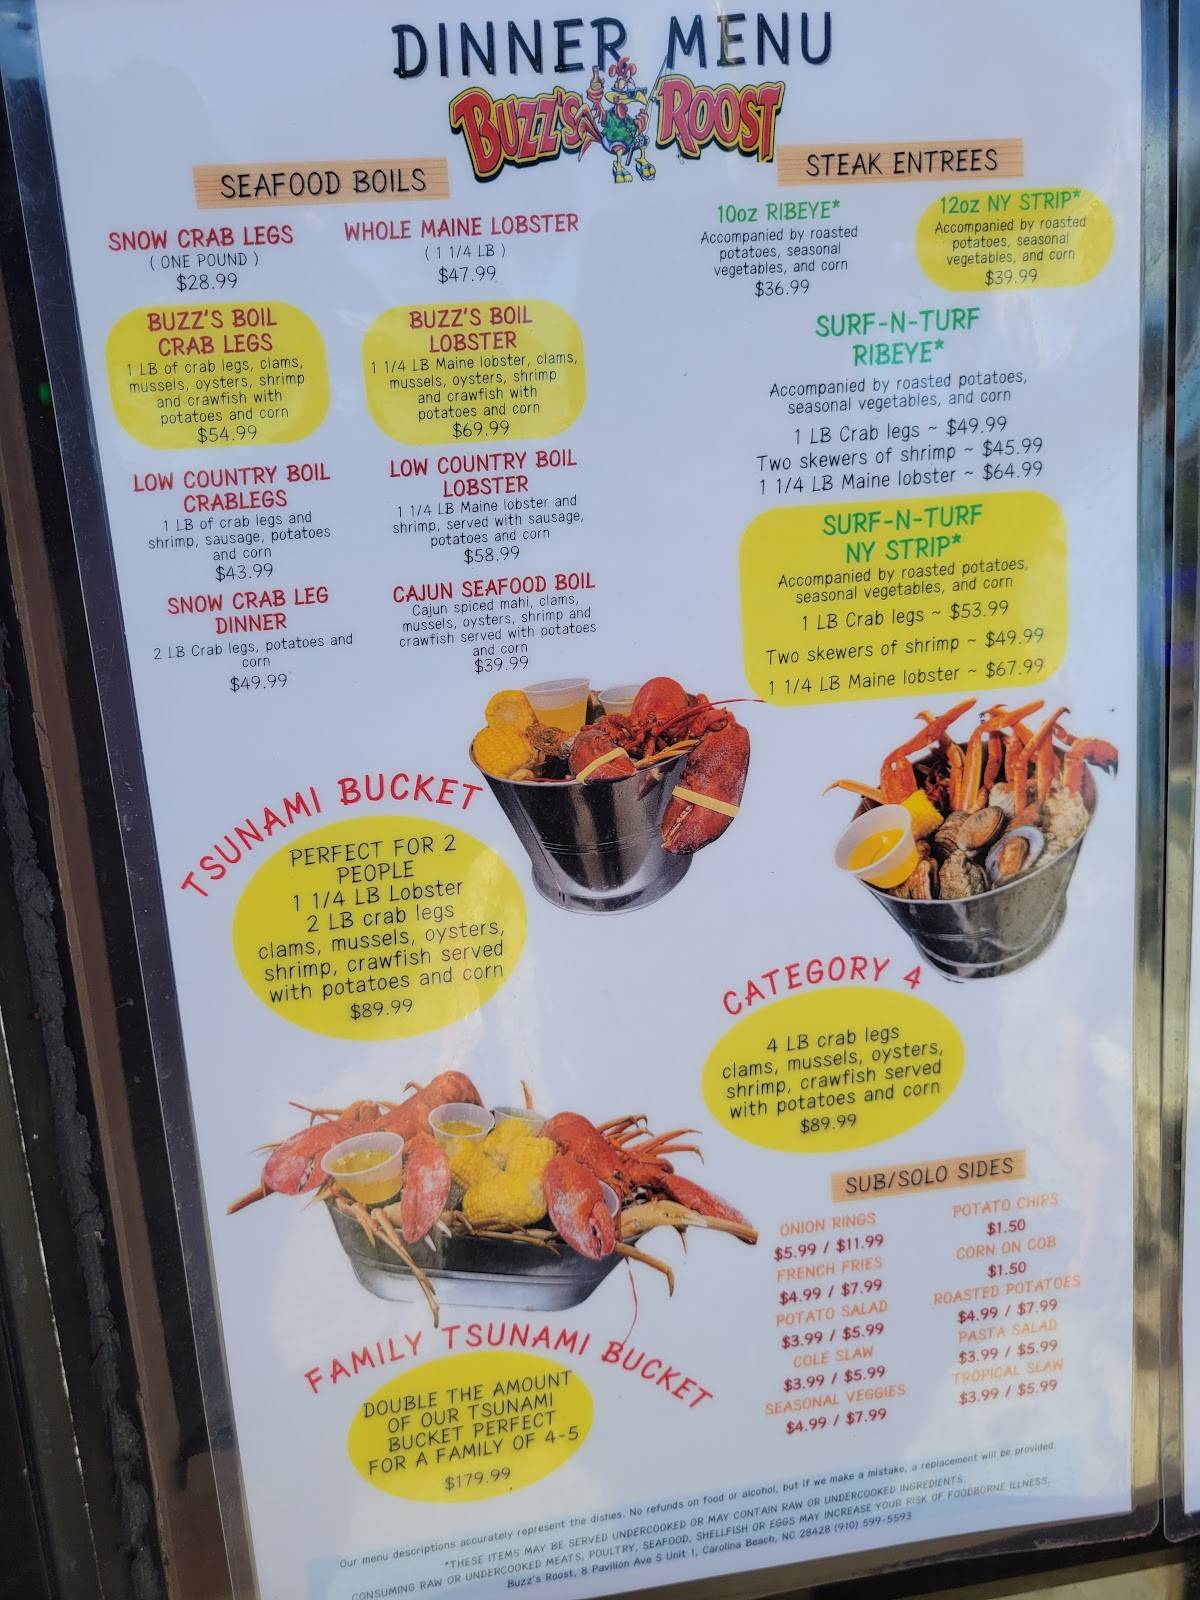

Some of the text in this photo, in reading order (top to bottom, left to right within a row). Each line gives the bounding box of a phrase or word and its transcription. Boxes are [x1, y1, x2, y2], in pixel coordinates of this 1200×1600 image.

[392, 12, 832, 79] DINNER MENU
[450, 76, 785, 178] BUZZ'S ROOST
[806, 148, 997, 177] STEAK ENTREES
[220, 167, 426, 199] SEAFOOD BOILS
[717, 204, 759, 224] 10oz
[940, 195, 980, 215] 12oz
[987, 193, 1011, 212] NY
[108, 224, 293, 251] SNOW CRAB LEGS
[343, 212, 578, 241] WHOLE MAINE LOBSTER
[700, 224, 857, 245] Accompanied by roasted
[719, 241, 840, 262] potatoes, seasonal
[437, 265, 495, 284] $47.99
[713, 258, 847, 278] vegetables, and corn
[984, 268, 1037, 287] $39.99
[176, 272, 237, 292] $28.99
[754, 279, 809, 298] $36.99
[146, 307, 277, 332] BUZZ'S BOIL
[408, 304, 533, 330] BUZZ'S BOIL
[815, 306, 980, 337] SURF-N-TURF
[158, 332, 273, 356] CRAB LEGS
[429, 330, 517, 353] LOBSTER
[197, 424, 257, 444] $54.99
[451, 419, 509, 439] $69.99
[389, 448, 577, 478] LOW COUNTRY BOIL
[133, 462, 331, 492] LOW COUNTRY BOIL
[442, 474, 528, 498] LOBSTER
[183, 489, 287, 513] CRABLEGS
[822, 503, 983, 536] SURF-N-TURF
[463, 545, 519, 565] $58.99
[845, 540, 876, 564] NY
[215, 562, 273, 582] $43.99
[393, 571, 595, 603] CAJUN SEAFOOD BOIL
[167, 585, 328, 614] SNOW CRAB LEG
[215, 612, 287, 634] DINNER
[474, 655, 528, 674] $39.99
[229, 672, 287, 693] $49.99
[181, 773, 483, 896] TSUNAMI BUCKET
[288, 834, 456, 867] PERFECT FOR 2
[336, 859, 414, 884] PEOPLE
[722, 956, 922, 1016] CATEGORY 4
[350, 998, 412, 1020] $89.99
[722, 1042, 942, 1079] clams, mussels, oysters,
[799, 1113, 856, 1135] $89.99
[845, 1157, 1014, 1194] SUB/SOLO SIDES
[952, 1193, 1058, 1217] POTATO CHIPS
[780, 1212, 876, 1236] ONION RINGS
[986, 1218, 1025, 1236] $1.50
[956, 1236, 1056, 1260] CORN ON COB
[777, 1257, 882, 1281] FRENCH FRIES
[987, 1260, 1026, 1279] $1.50
[932, 1275, 1081, 1306] ROASTED POTATOES
[776, 1299, 887, 1327] POTATO SALAD
[304, 1324, 713, 1407] FAMILY TSUNAMI BUCKET
[793, 1345, 874, 1368] COLE SLAW
[363, 1369, 572, 1418] DOUBLE THE AMOUNT
[765, 1385, 905, 1415] SEASONAL VEGGIES
[444, 1466, 511, 1492] $179.99
[339, 1558, 357, 1568] Our
[362, 1551, 388, 1565] menu
[392, 1538, 456, 1559] descriptions
[459, 1530, 513, 1547] accurately
[517, 1519, 565, 1536] represent
[569, 1517, 586, 1527] the
[629, 1506, 645, 1517] No
[646, 1500, 684, 1514] refunds
[687, 1498, 699, 1508] on
[702, 1492, 724, 1504] food
[741, 1484, 778, 1498] alcohol,
[782, 1480, 799, 1492] but
[802, 1478, 810, 1488] if
[813, 1477, 827, 1488] we
[829, 1472, 854, 1483] make
[920, 1453, 978, 1472] replacement
[981, 1450, 996, 1460] will
[1000, 1447, 1010, 1457] be
[488, 1548, 519, 1562] ITEMS
[524, 1543, 546, 1556] MAY
[550, 1540, 563, 1552] BE
[568, 1532, 608, 1548] SERVED
[611, 1519, 686, 1540] UNDERCOOKED
[689, 1516, 704, 1527] OR
[707, 1511, 729, 1524] MAY
[733, 1504, 777, 1520] CONTAIN
[781, 1499, 803, 1512] RAW
[806, 1496, 820, 1507] OR
[823, 1485, 896, 1505] UNDERCOOKED
[506, 1574, 541, 1588] Buzz's
[545, 1568, 576, 1581] Roost,
[580, 1566, 588, 1576] 8
[591, 1560, 629, 1573] Pavilion
[633, 1556, 652, 1567] Ave
[655, 1552, 662, 1562] S
[665, 1549, 685, 1560] Unit
[702, 1541, 742, 1554] Carolina
[745, 1535, 777, 1547] Beach,
[781, 1530, 795, 1541] NC
[799, 1524, 831, 1538] 28428
[833, 1519, 858, 1532] (910)
[862, 1511, 912, 1528] 599-5593
